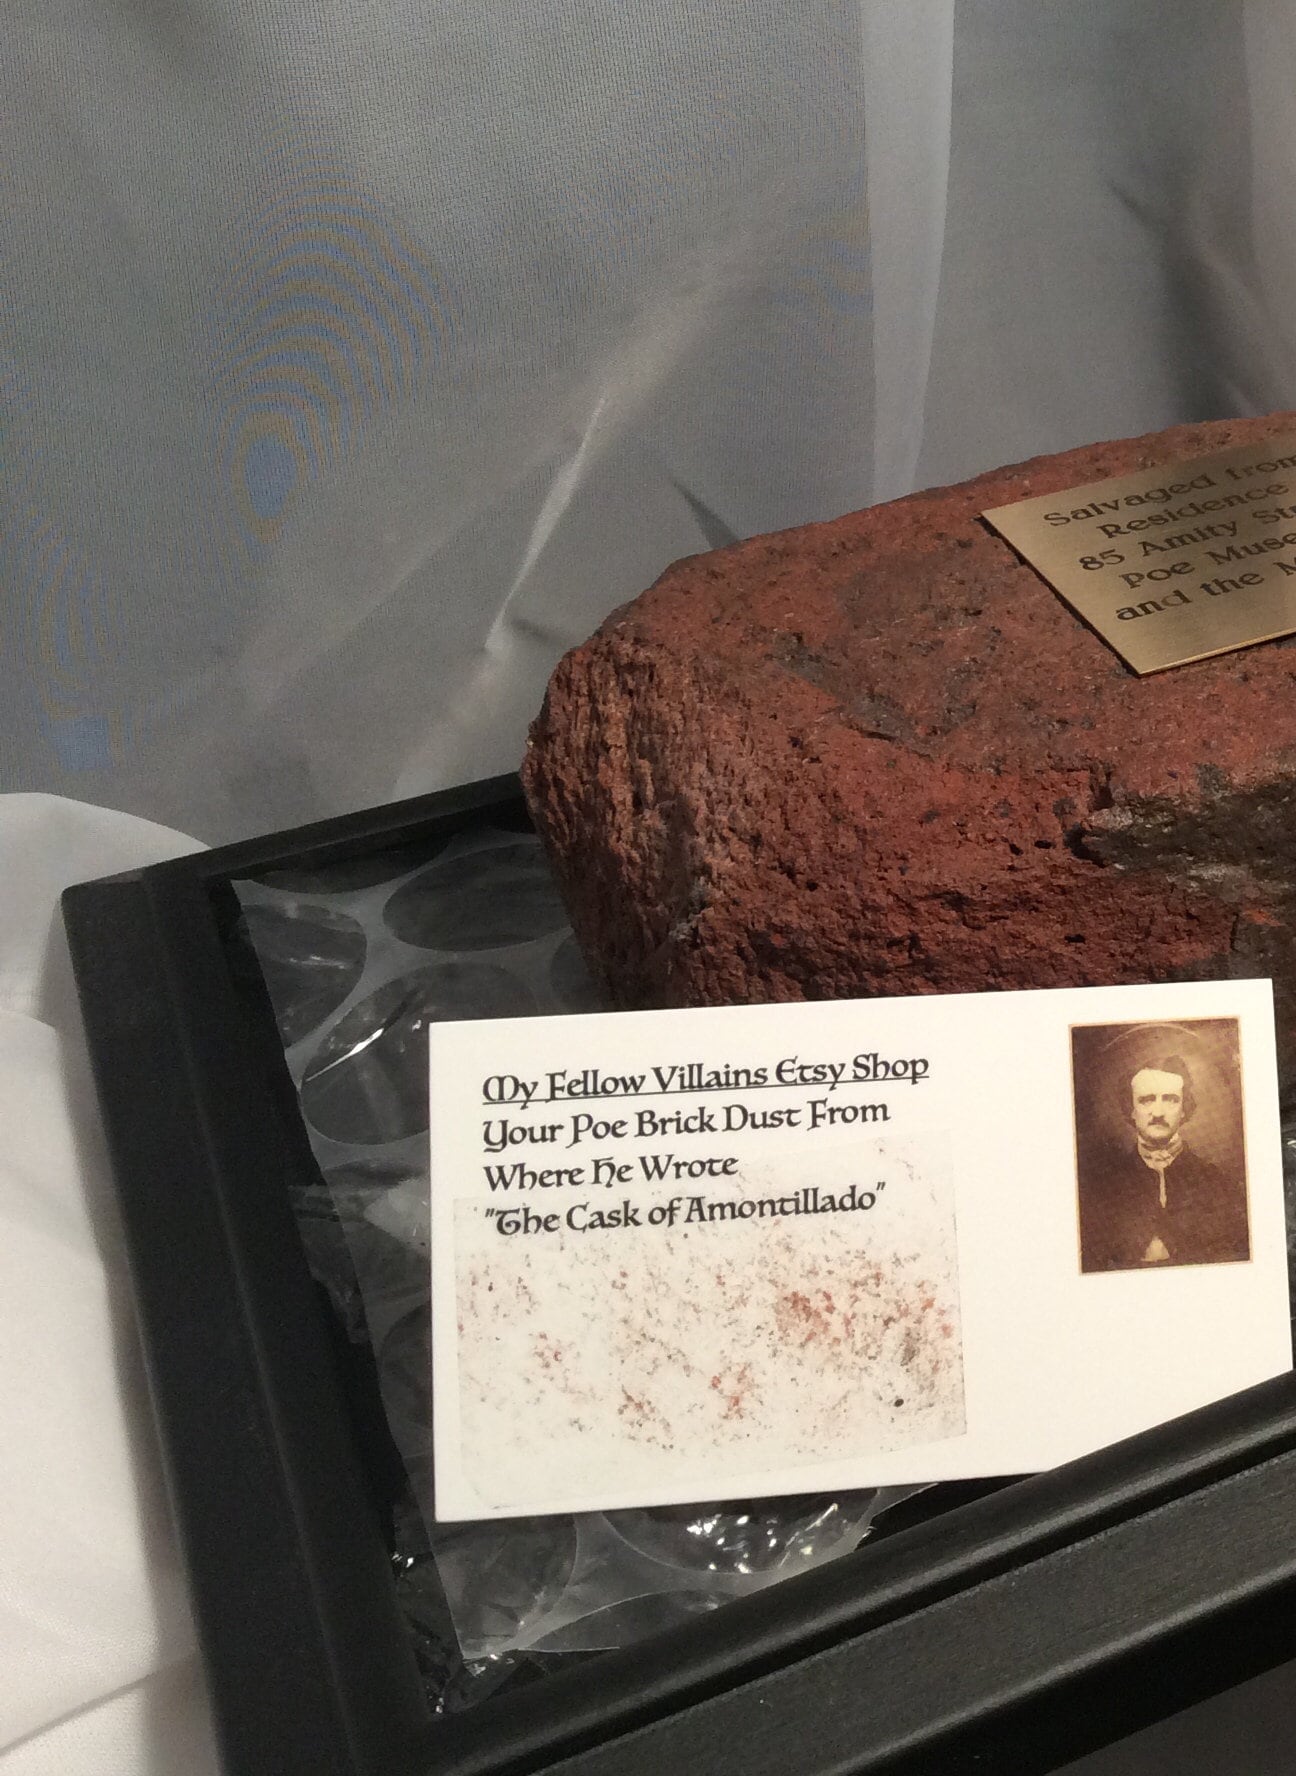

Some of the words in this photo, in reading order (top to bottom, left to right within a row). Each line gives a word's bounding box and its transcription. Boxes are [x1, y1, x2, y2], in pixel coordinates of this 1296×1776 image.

[1044, 474, 1215, 527] Salvaged
[1097, 481, 1289, 539] Residence
[1079, 548, 1125, 572] 85
[1138, 520, 1239, 557] Amity
[1115, 590, 1193, 621] and
[1200, 570, 1264, 597] the
[1119, 560, 1195, 589] Poe
[482, 1073, 538, 1109] My
[545, 1067, 646, 1103] Fellow
[652, 1061, 769, 1094] Villains
[775, 1056, 846, 1091] Etsy
[852, 1052, 930, 1085] Shop
[482, 1117, 564, 1153] Your
[567, 1113, 628, 1148] Poe
[634, 1104, 718, 1139] Brick
[722, 1103, 801, 1132] Dust
[806, 1098, 891, 1131] From
[483, 1161, 585, 1192] Where
[591, 1157, 634, 1189] He
[639, 1154, 739, 1182] Wrote
[485, 1207, 560, 1237] "The
[566, 1200, 642, 1233] Cask
[647, 1195, 684, 1227] of
[684, 1181, 887, 1225] Amontillado"
